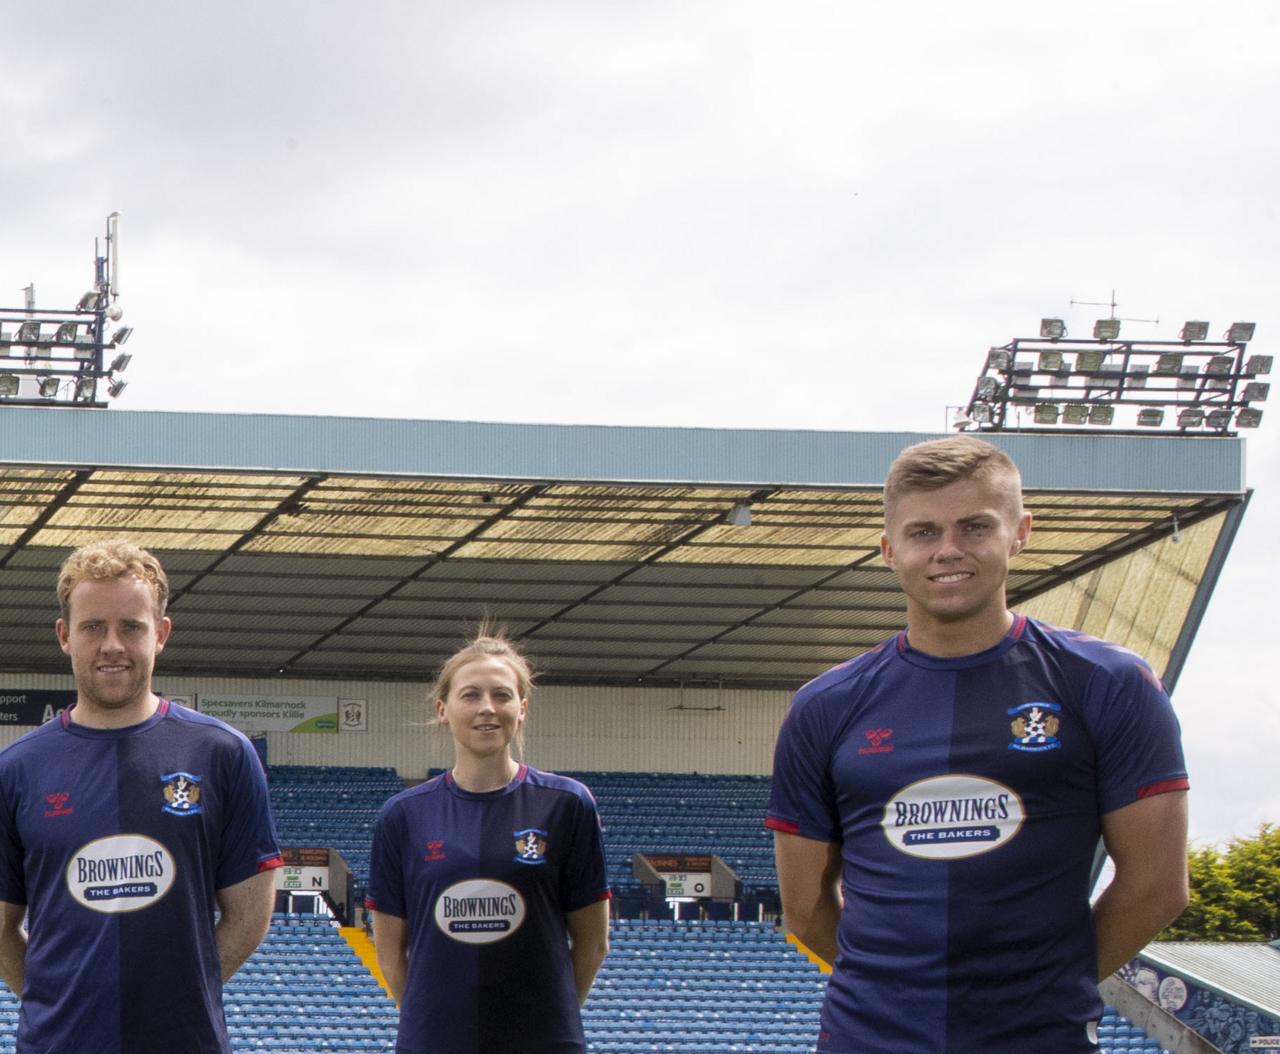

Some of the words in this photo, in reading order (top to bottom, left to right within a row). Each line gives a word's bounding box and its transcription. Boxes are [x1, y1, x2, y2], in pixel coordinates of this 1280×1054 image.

[201, 698, 253, 710] Specsavers
[254, 699, 306, 710] Kilmarnock
[240, 711, 281, 721] sponsors
[282, 710, 305, 720] Killie
[893, 793, 1010, 828] BROWNINGS
[909, 832, 936, 842] THE
[937, 828, 992, 840] BAKERS
[76, 850, 164, 884] BROWNINGS
[311, 876, 323, 888] N
[89, 888, 110, 897] THE
[112, 884, 152, 896] BAKERS
[442, 893, 517, 918] BROWNINGS
[471, 921, 506, 930] BAKERS
